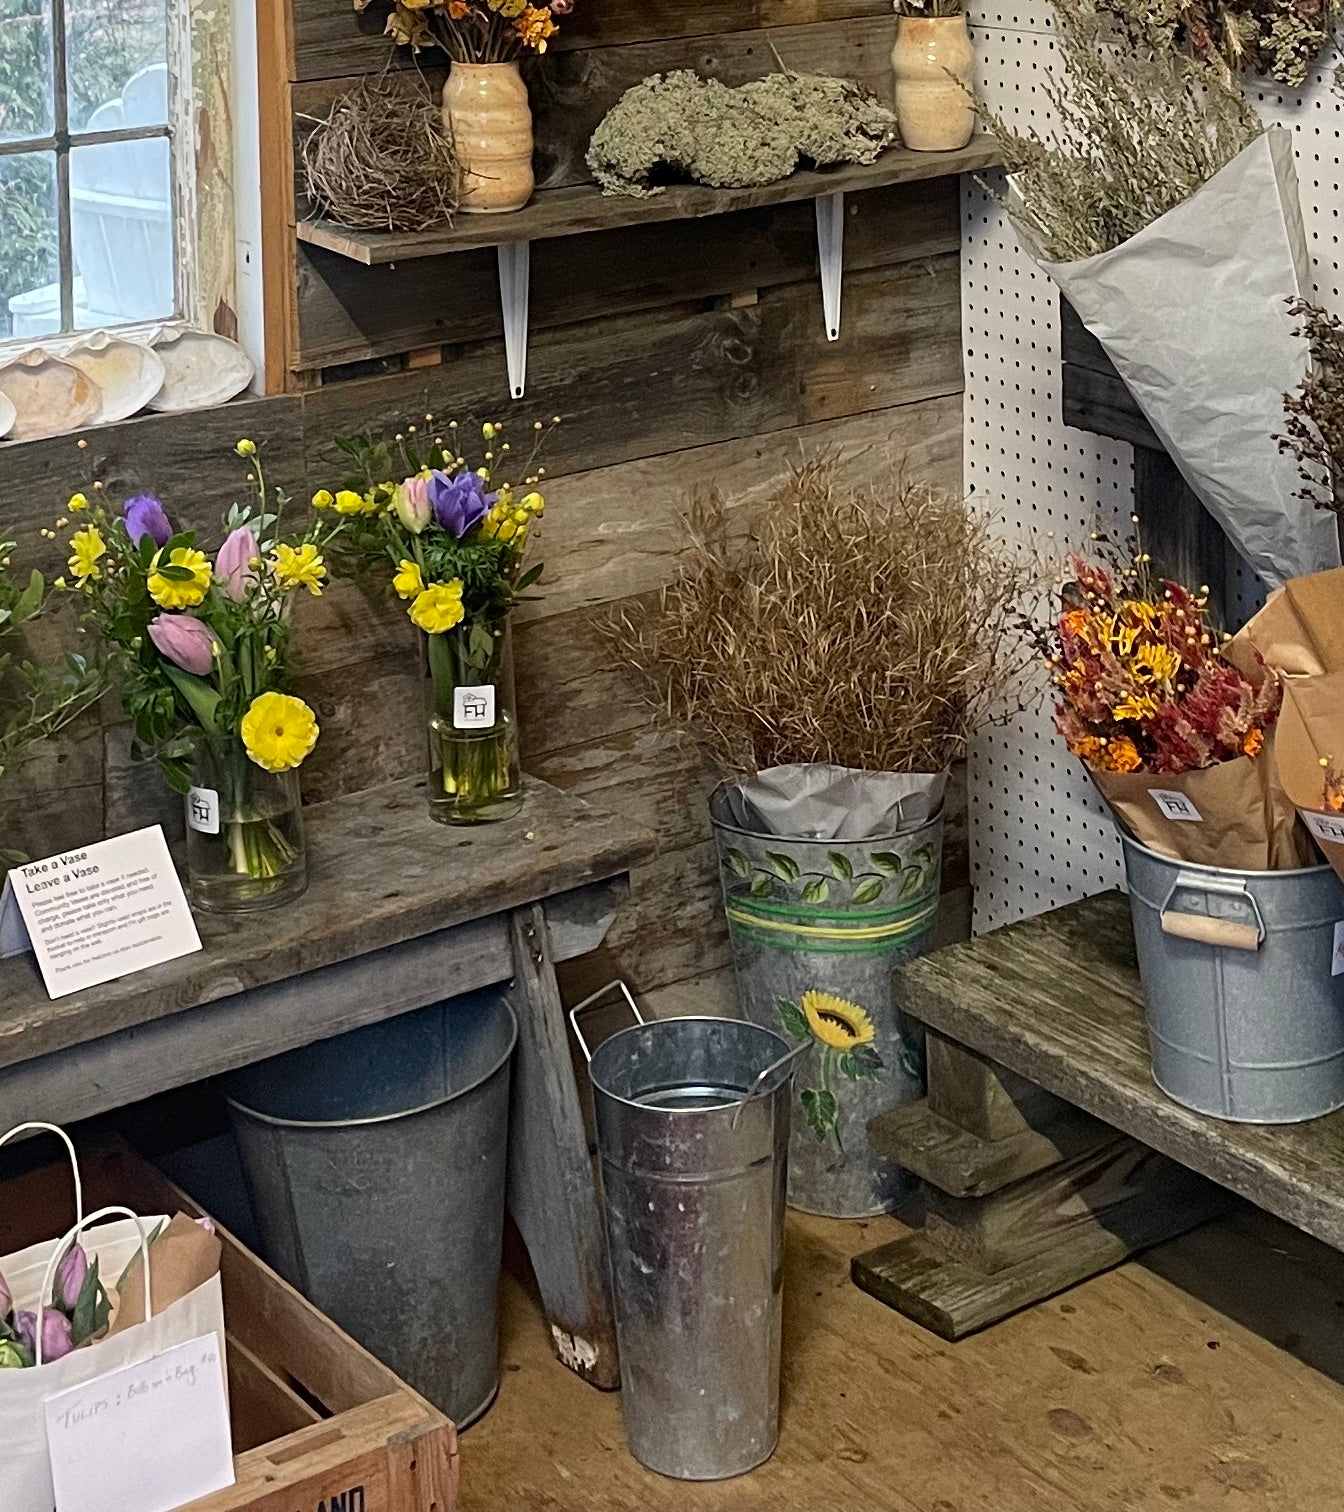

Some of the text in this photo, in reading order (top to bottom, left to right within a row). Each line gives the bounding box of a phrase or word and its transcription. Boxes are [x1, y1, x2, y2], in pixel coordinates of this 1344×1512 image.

[20, 852, 87, 878] Take a Vase
[25, 865, 99, 894] Leave a Vase
